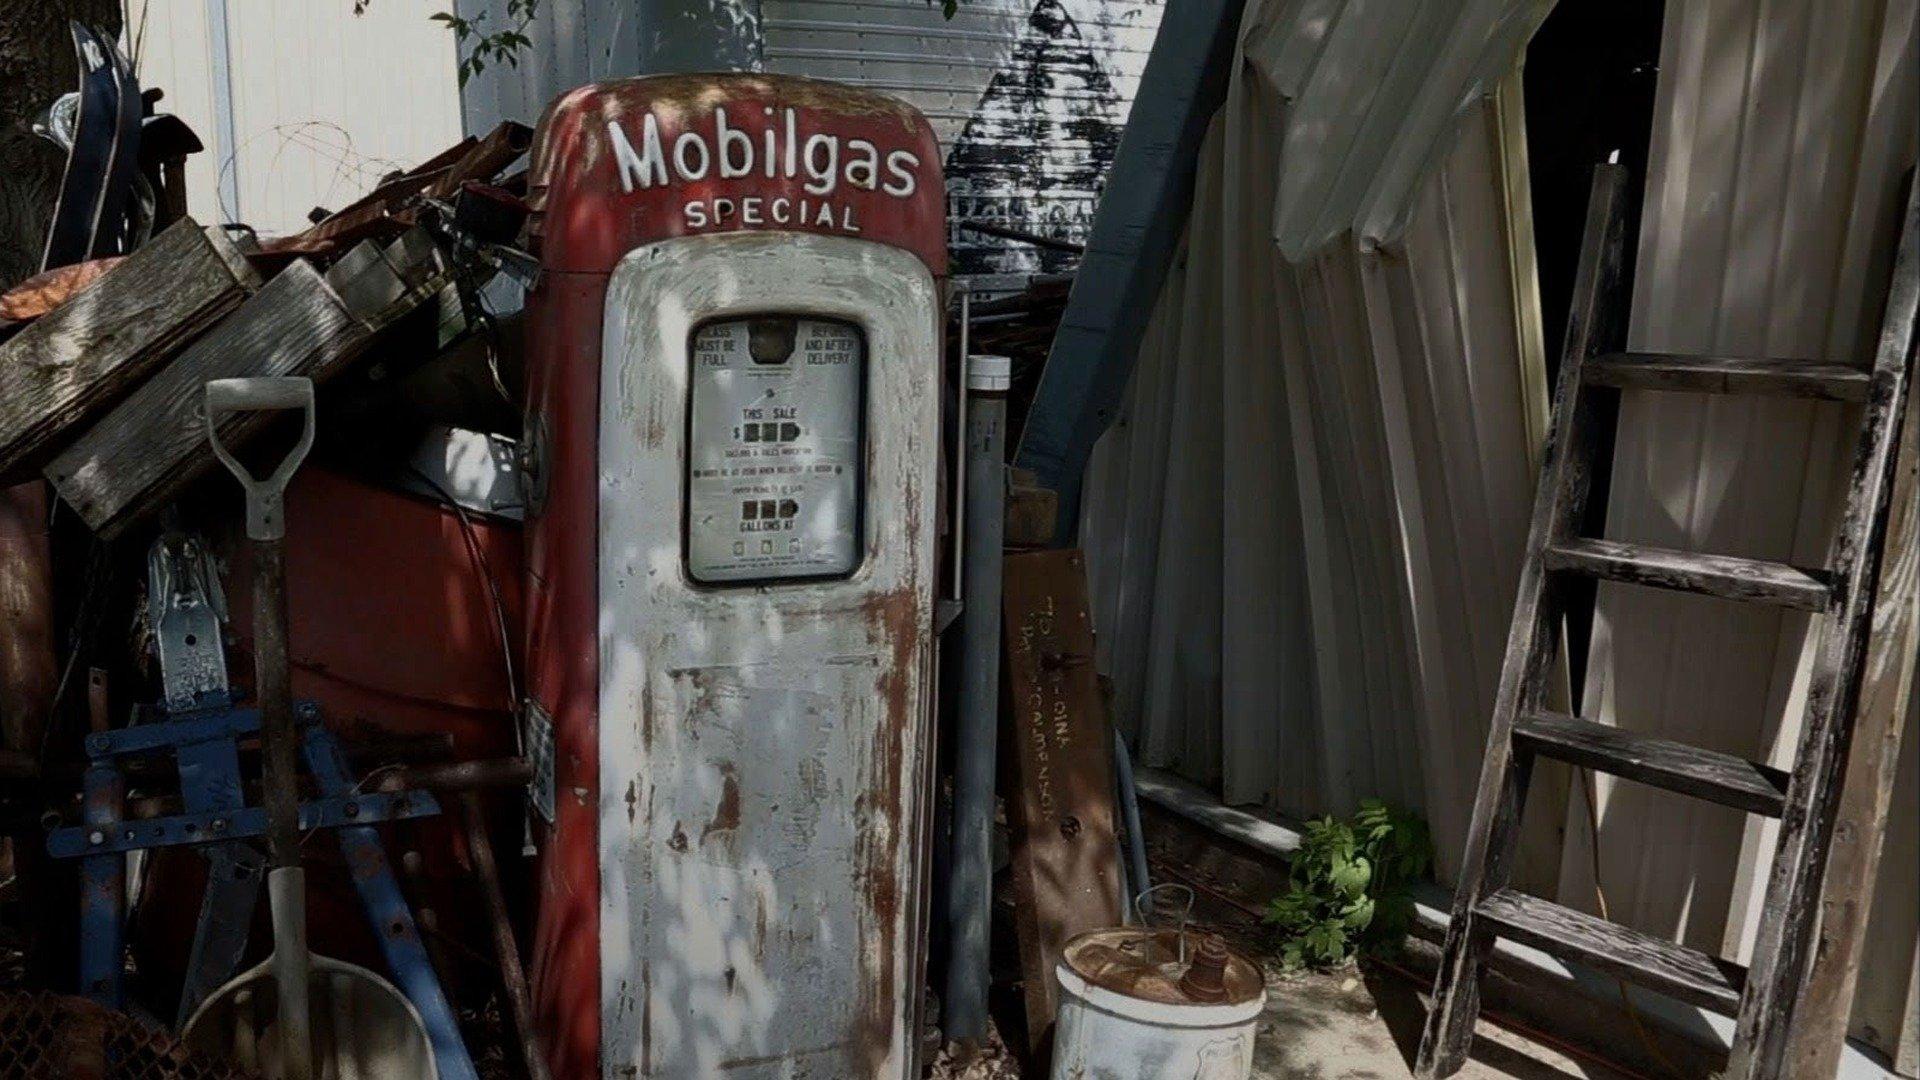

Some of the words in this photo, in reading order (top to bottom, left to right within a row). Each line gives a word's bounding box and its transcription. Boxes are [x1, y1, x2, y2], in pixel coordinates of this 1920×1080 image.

[608, 107, 919, 197] Mobilgas
[684, 198, 861, 232] SPECIAL
[805, 339, 822, 351] AND
[702, 353, 727, 366] FULL
[807, 353, 850, 366] DELIVERY
[743, 408, 763, 419] THIS
[773, 407, 797, 419] SALE
[740, 521, 779, 532] GALLONS
[785, 520, 794, 531] AT
